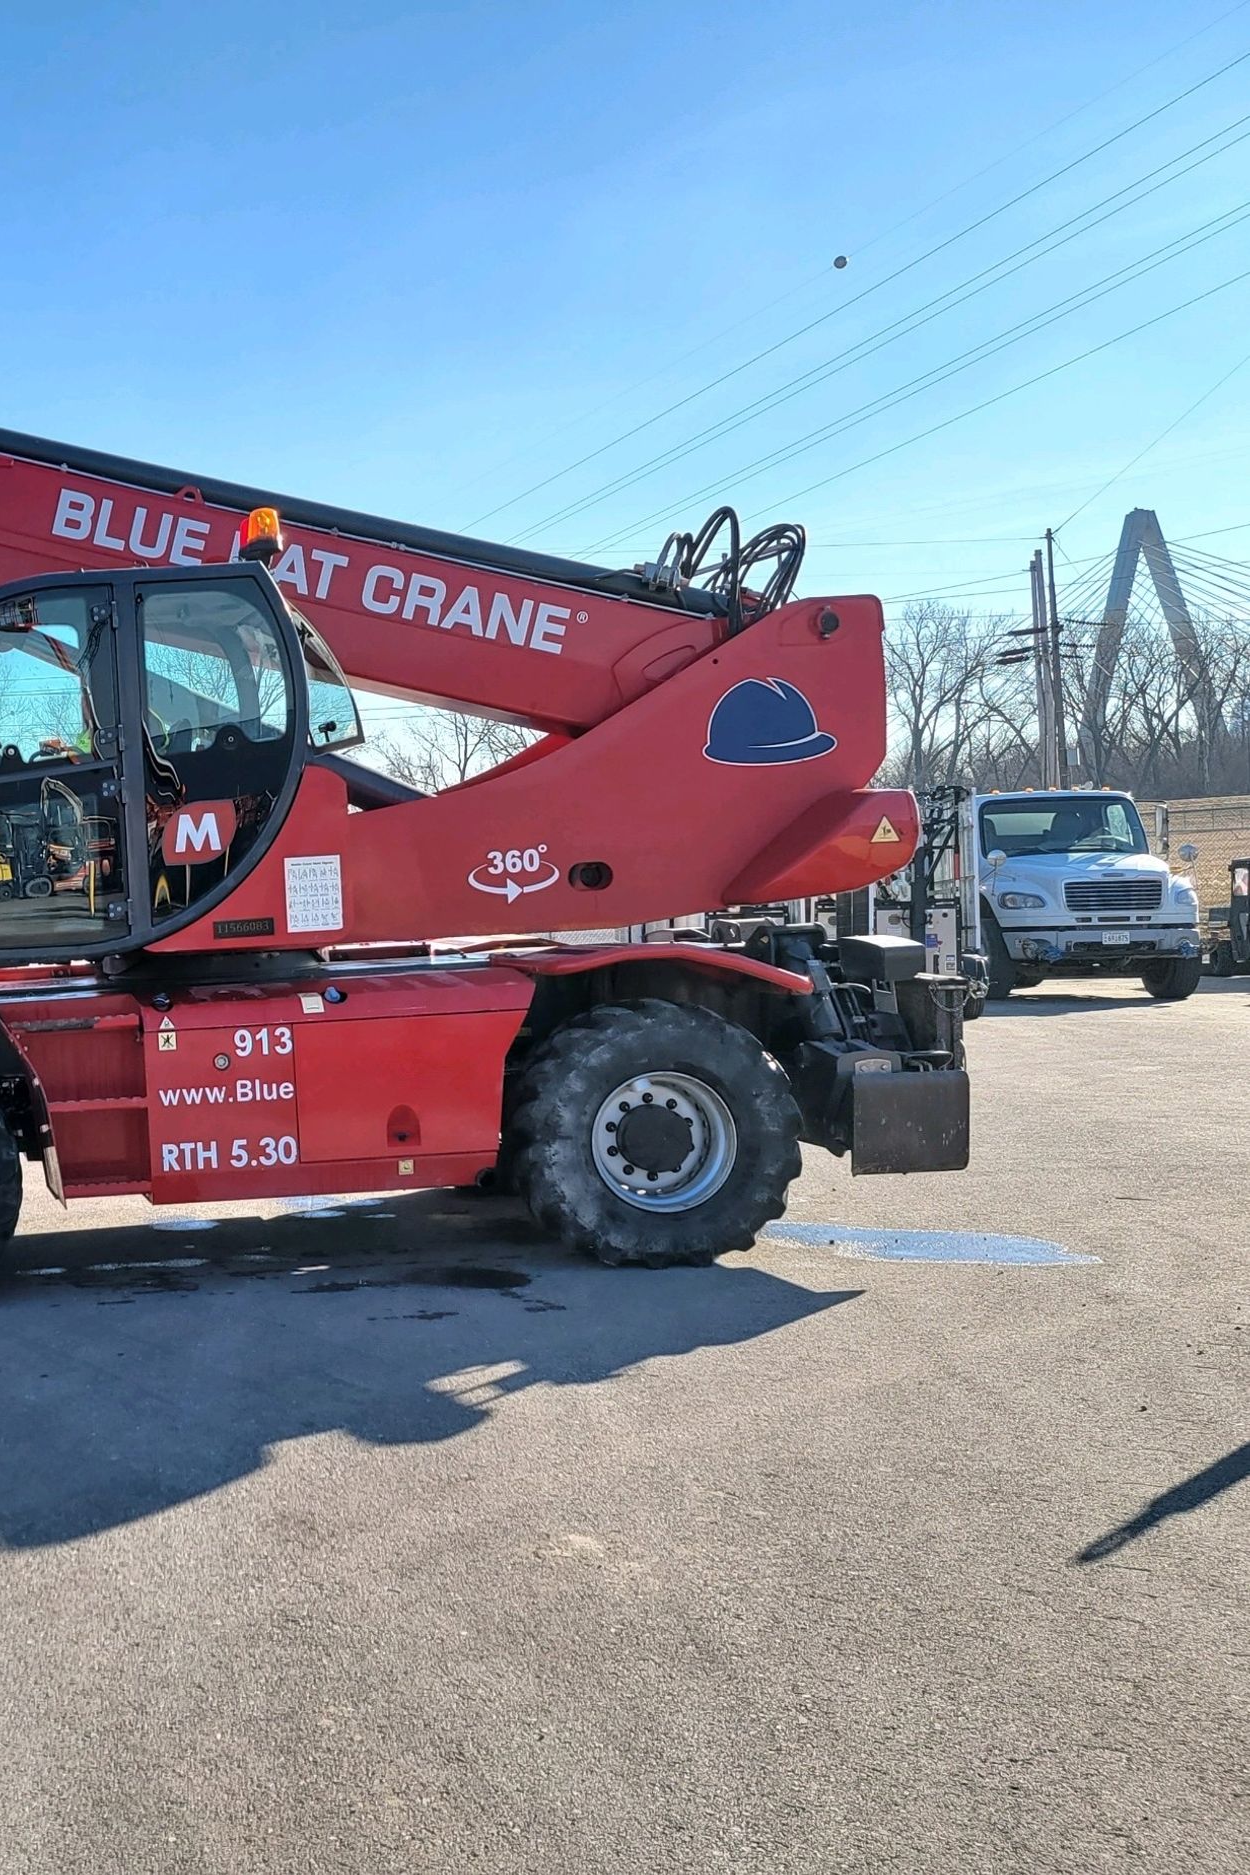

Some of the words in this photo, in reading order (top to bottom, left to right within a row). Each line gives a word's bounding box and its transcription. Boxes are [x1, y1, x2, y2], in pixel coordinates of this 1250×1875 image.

[51, 488, 211, 567] BLUE
[229, 530, 350, 601] AT
[175, 812, 222, 853] M
[233, 1026, 293, 1057] 913
[158, 1078, 296, 1107] www.Blue
[162, 1142, 219, 1172] RTH
[230, 1135, 299, 1168] 5.30
